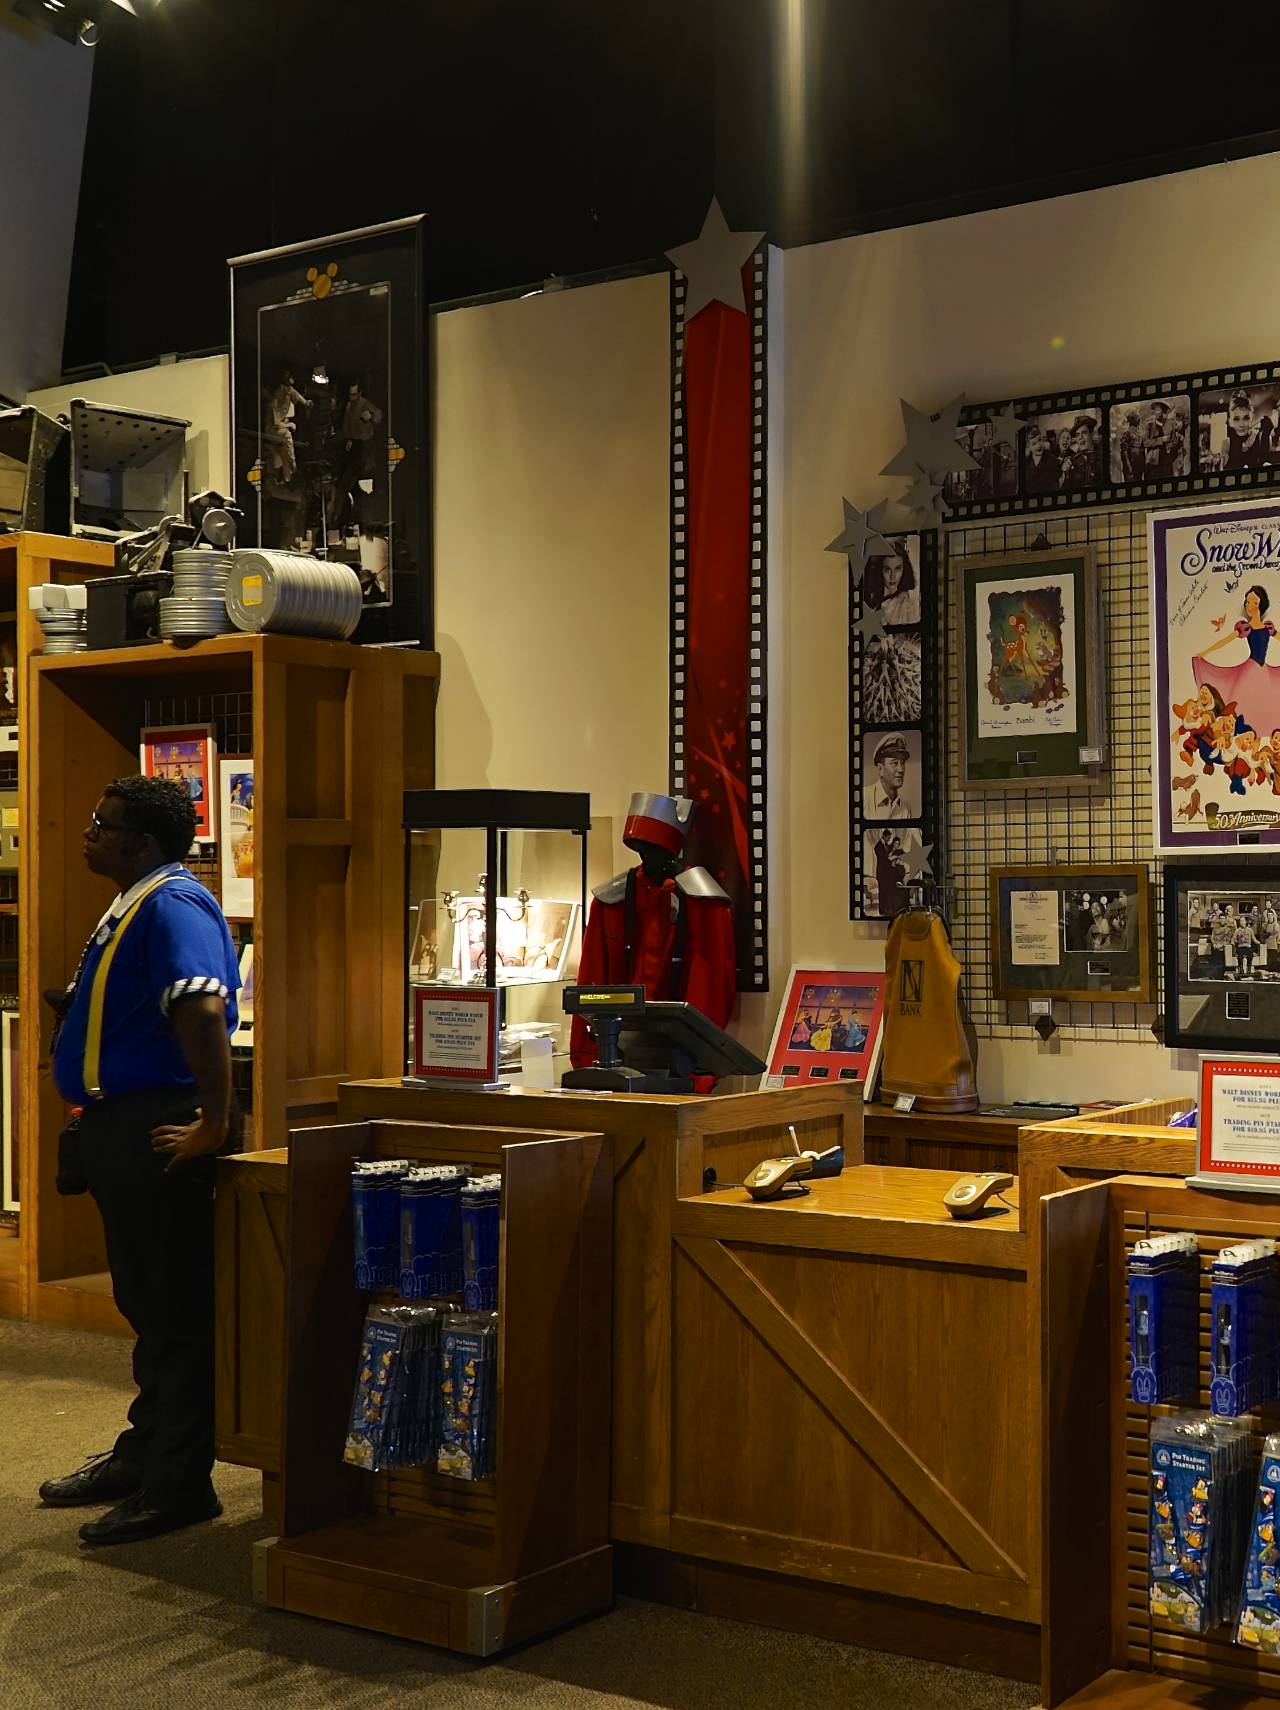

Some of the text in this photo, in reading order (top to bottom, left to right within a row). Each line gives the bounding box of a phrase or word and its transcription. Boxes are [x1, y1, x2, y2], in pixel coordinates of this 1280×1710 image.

[1180, 528, 1257, 576] Snow
[1222, 1088, 1238, 1096] WALT
[1239, 1089, 1262, 1097] DISNEY
[1223, 1118, 1252, 1126] TRADING
